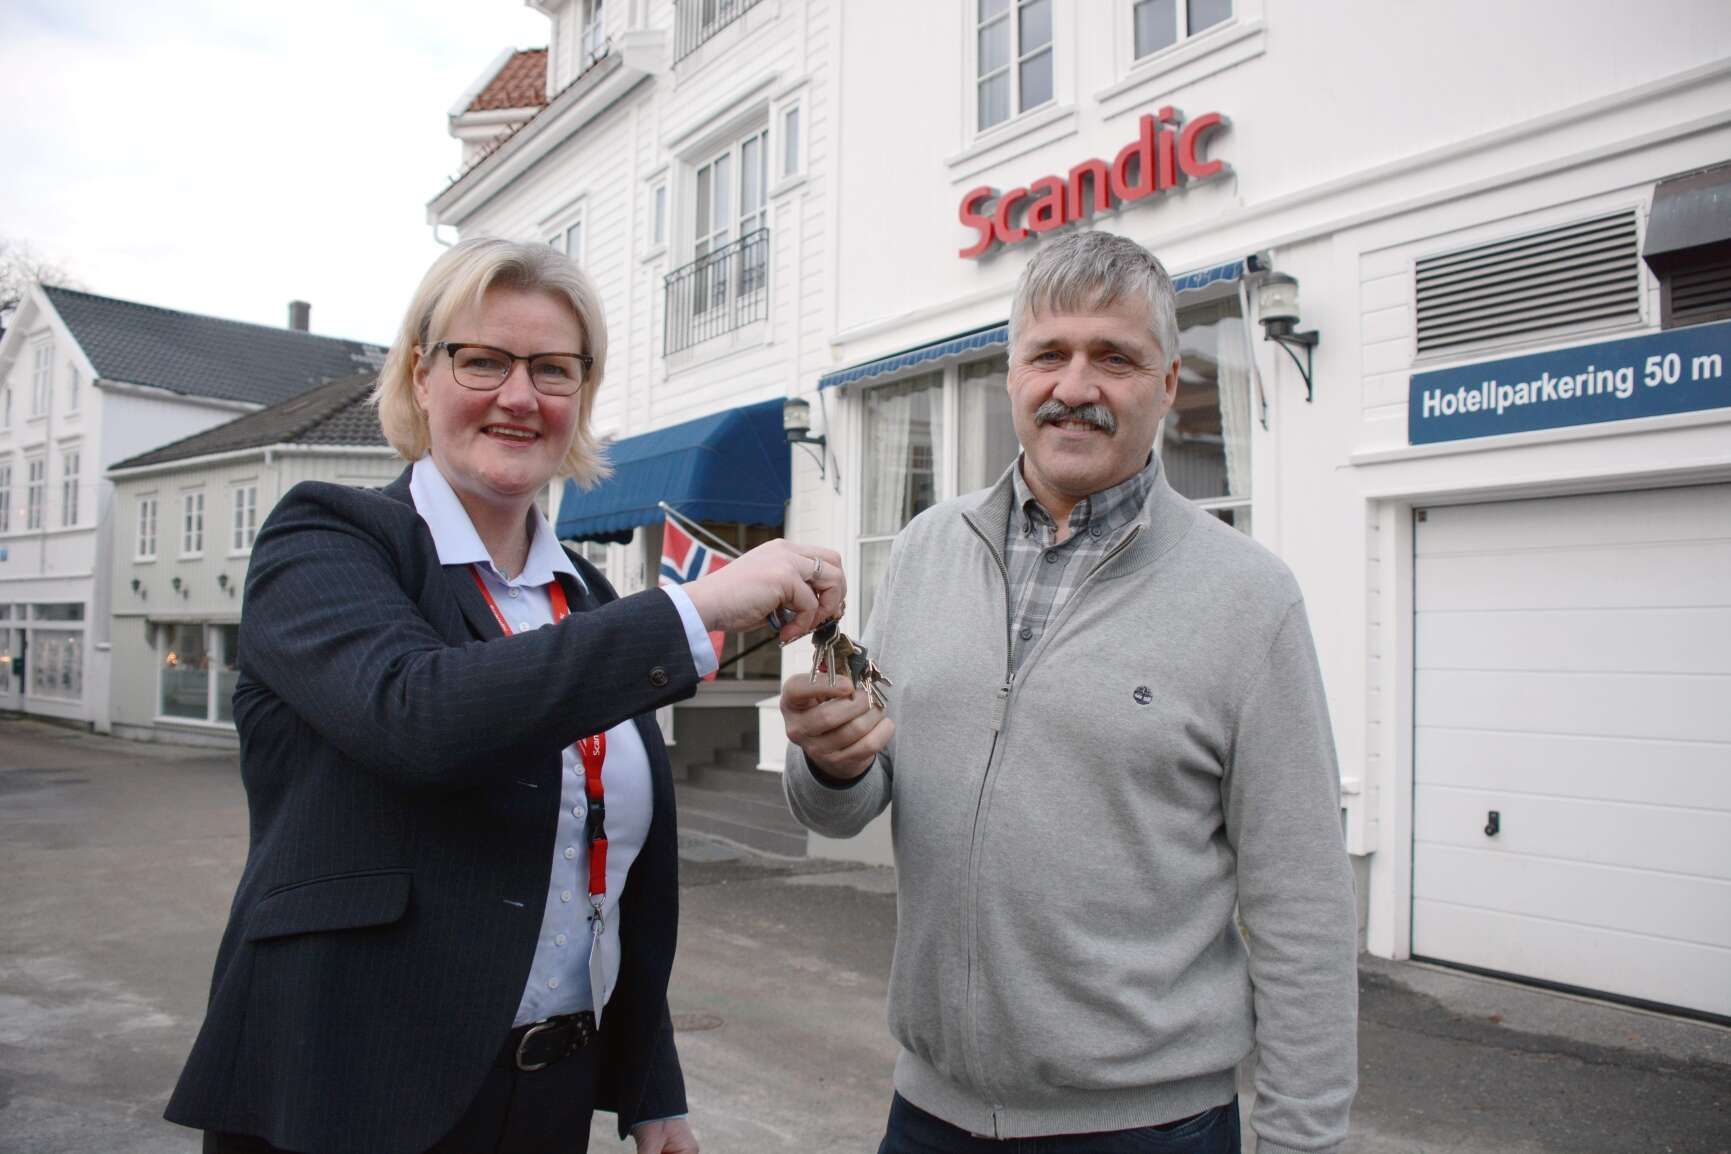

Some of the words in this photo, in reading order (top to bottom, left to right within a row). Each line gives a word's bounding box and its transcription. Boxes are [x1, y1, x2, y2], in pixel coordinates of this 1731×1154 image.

[959, 105, 1226, 258] Scandic
[1422, 365, 1635, 418] Hotellparkering
[1644, 352, 1682, 387] 50
[1692, 353, 1723, 380] m
